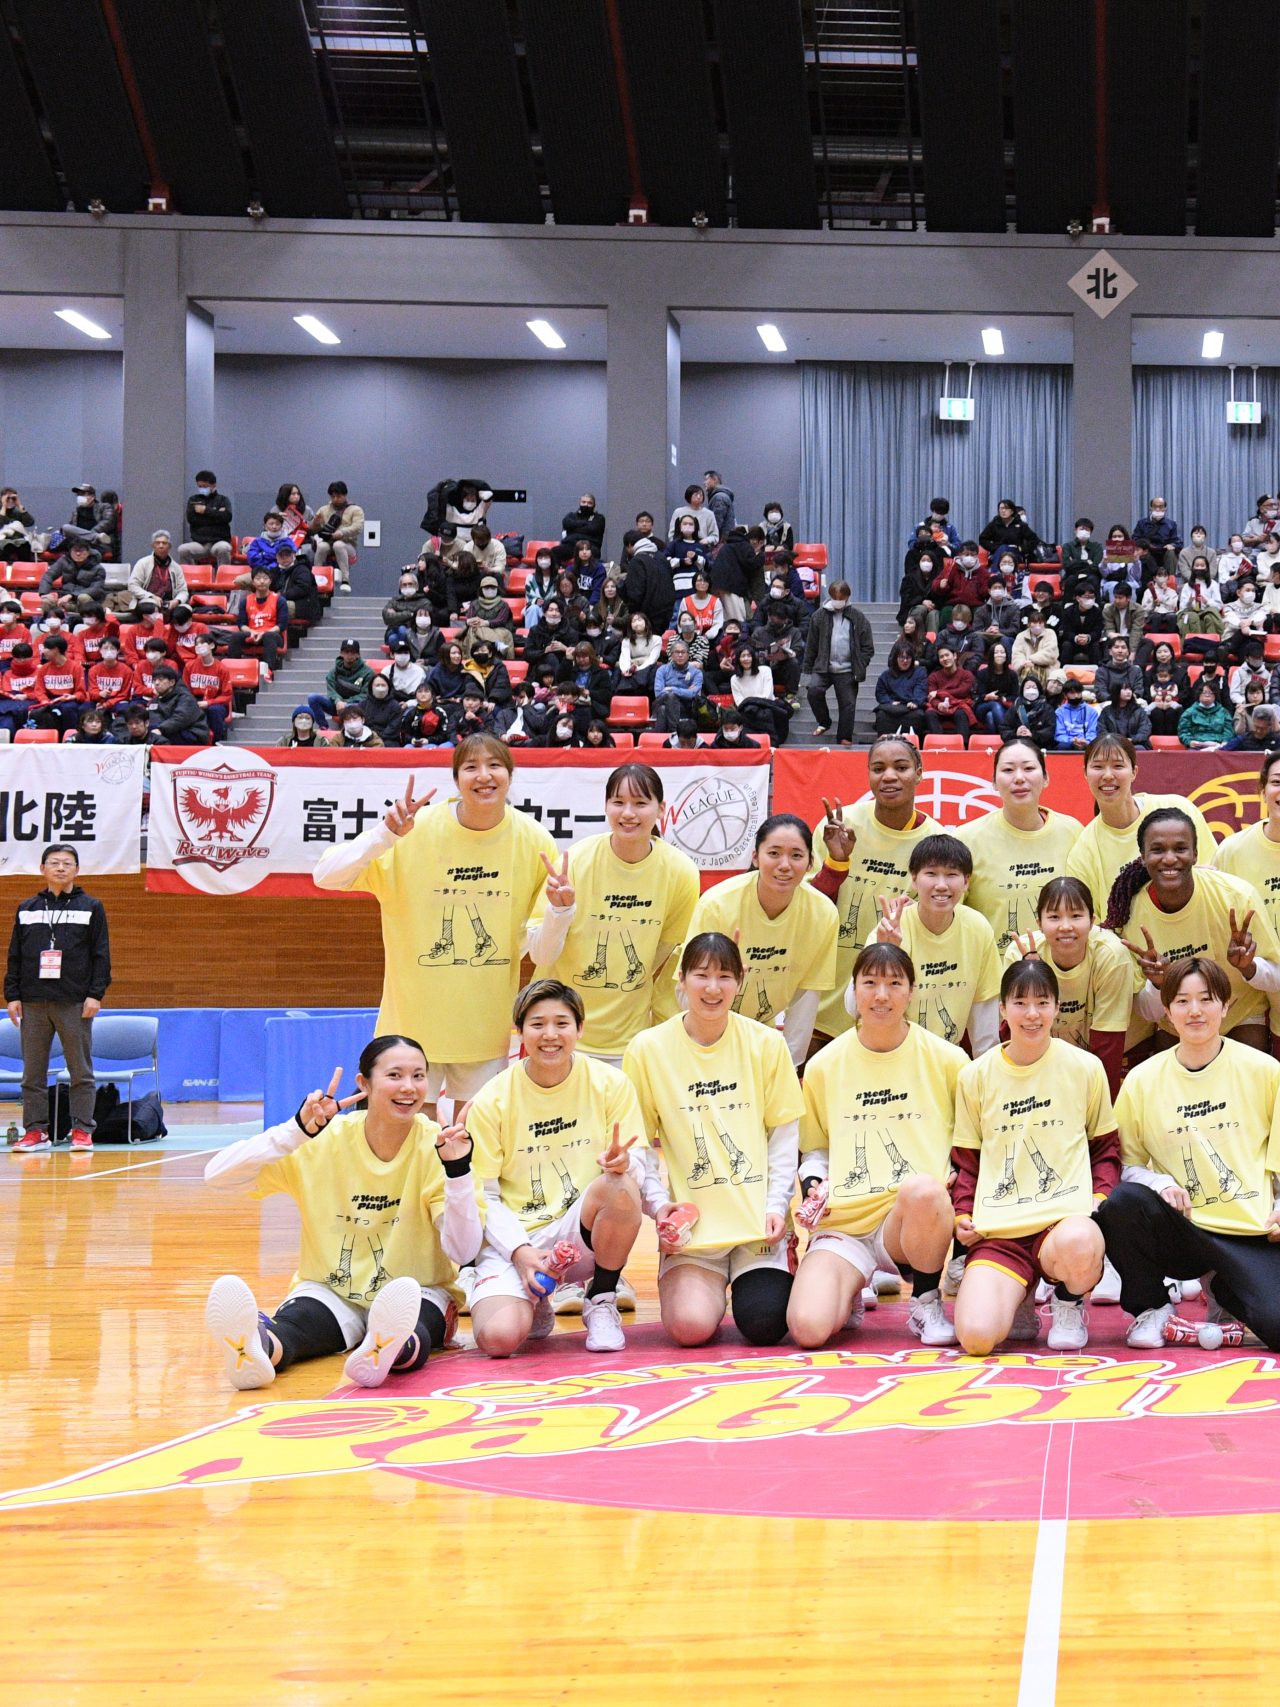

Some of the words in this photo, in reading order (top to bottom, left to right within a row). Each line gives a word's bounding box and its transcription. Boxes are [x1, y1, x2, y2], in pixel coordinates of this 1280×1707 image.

[1086, 267, 1118, 300] 北
[682, 789, 737, 820] LEAGUE
[0, 790, 97, 842] 北陸
[176, 839, 215, 857] Red
[709, 853, 735, 866] Japan
[862, 859, 895, 868] #Keep
[447, 867, 483, 875] #Keep
[867, 865, 907, 877] Playing
[1009, 863, 1040, 872] #Keep
[1015, 866, 1054, 876] Playing
[453, 871, 498, 881] Playing
[610, 899, 652, 908] Playing
[921, 961, 947, 971] #Keep
[925, 962, 957, 976] Playing
[688, 1079, 720, 1092] #Keep
[695, 1082, 737, 1098] Playing
[856, 1088, 891, 1100] #Keep
[862, 1091, 907, 1107] Playing
[1003, 1096, 1036, 1111] #Keep
[1010, 1097, 1051, 1116] Playing
[1177, 1100, 1210, 1113] #Keep
[1184, 1101, 1226, 1119] Playing
[529, 1116, 562, 1132] #Keep
[534, 1119, 577, 1137] Playing
[352, 1195, 388, 1203] #Keep
[357, 1198, 400, 1210] Playing
[440, 1350, 1107, 1403] Sunshine
